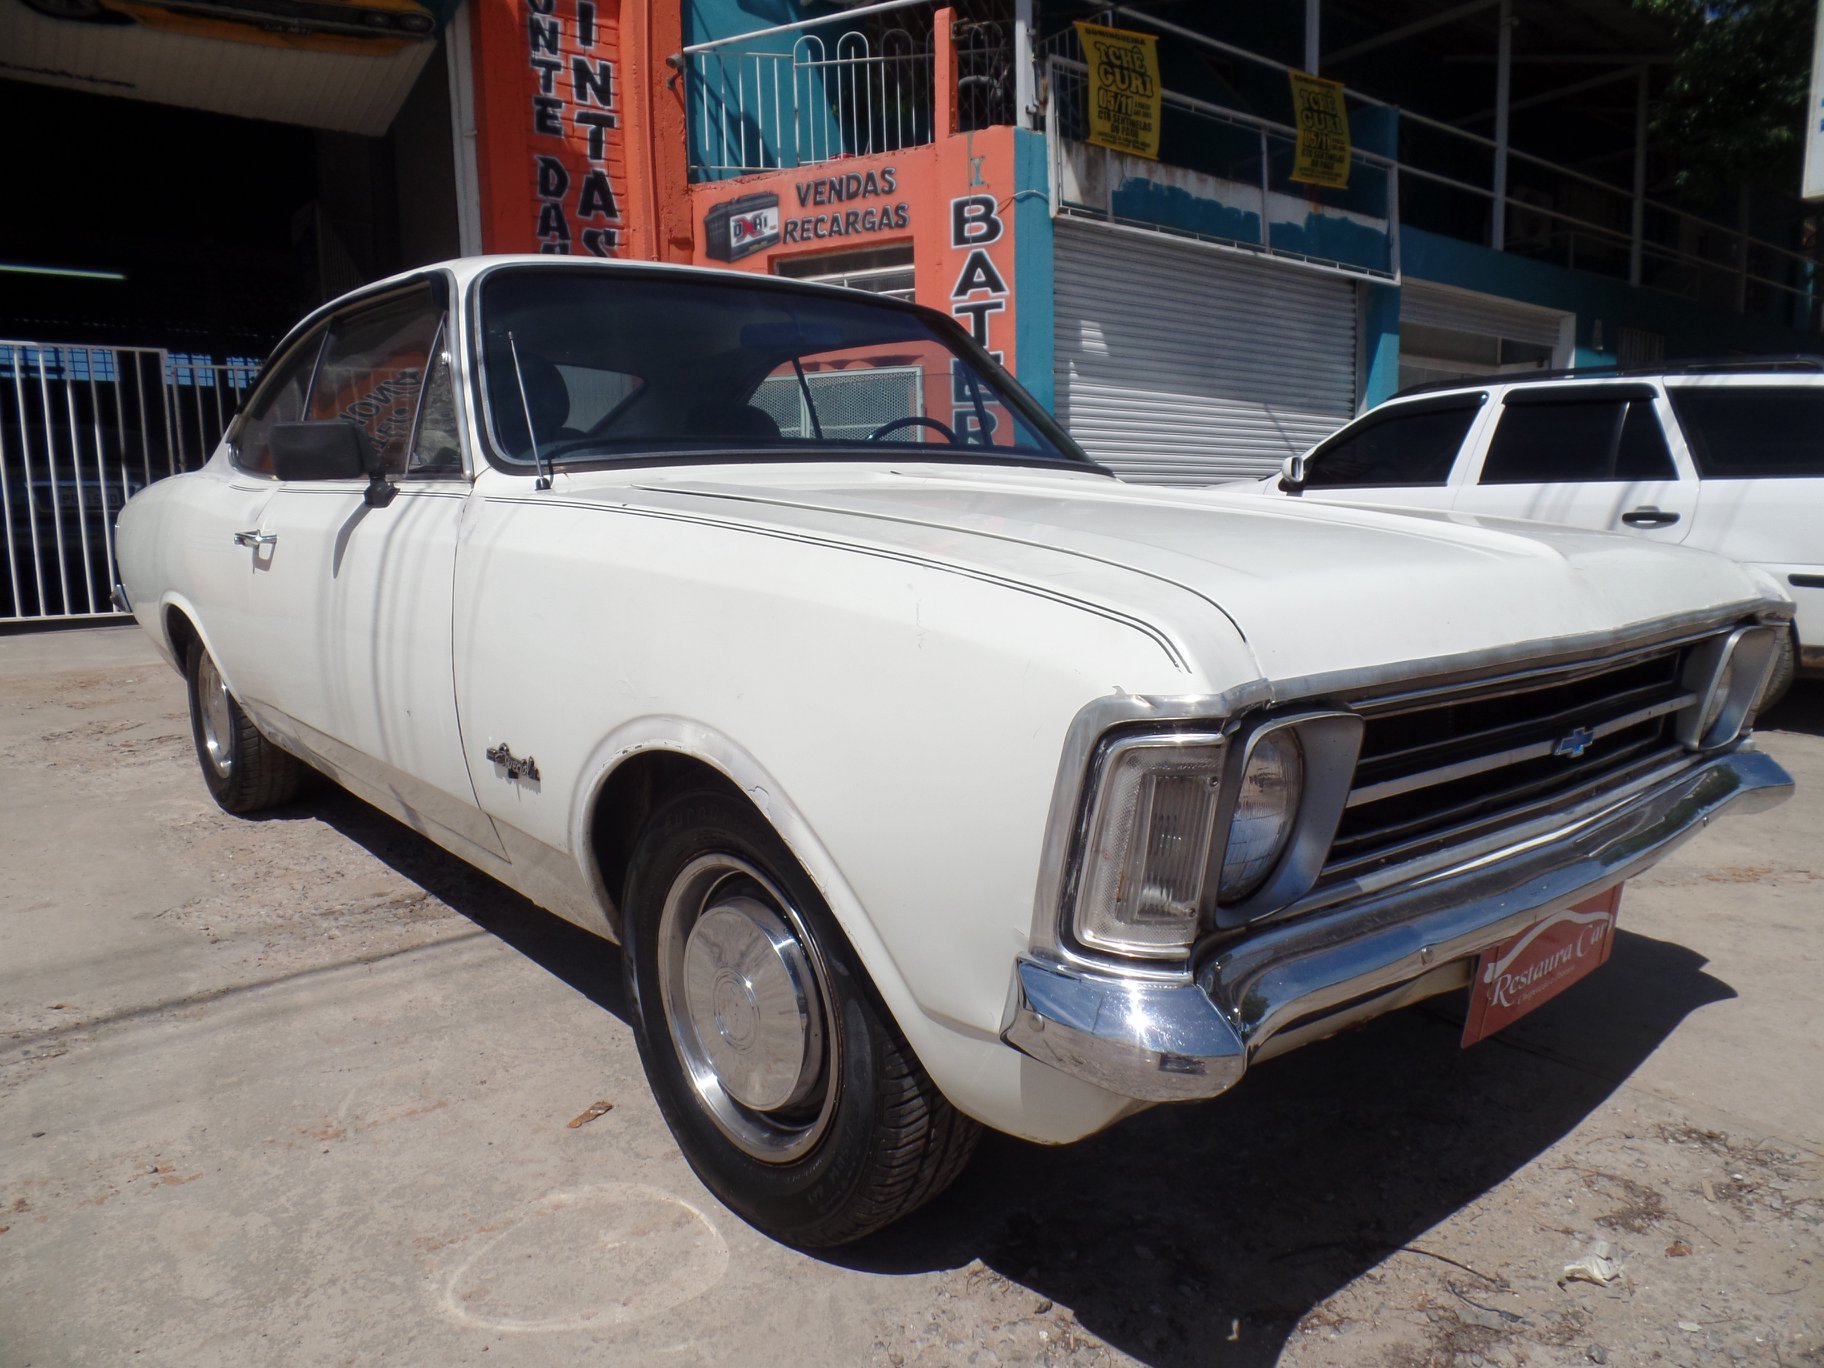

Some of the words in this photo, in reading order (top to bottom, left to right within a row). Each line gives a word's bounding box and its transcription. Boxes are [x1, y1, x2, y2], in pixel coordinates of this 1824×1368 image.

[1098, 86, 1134, 116] 05/11
[535, 154, 572, 255] DA
[796, 167, 896, 208] VENDAS
[782, 203, 910, 244] RECARGAS
[1488, 943, 1574, 1008] Restaura
[1576, 921, 1607, 957] Car
